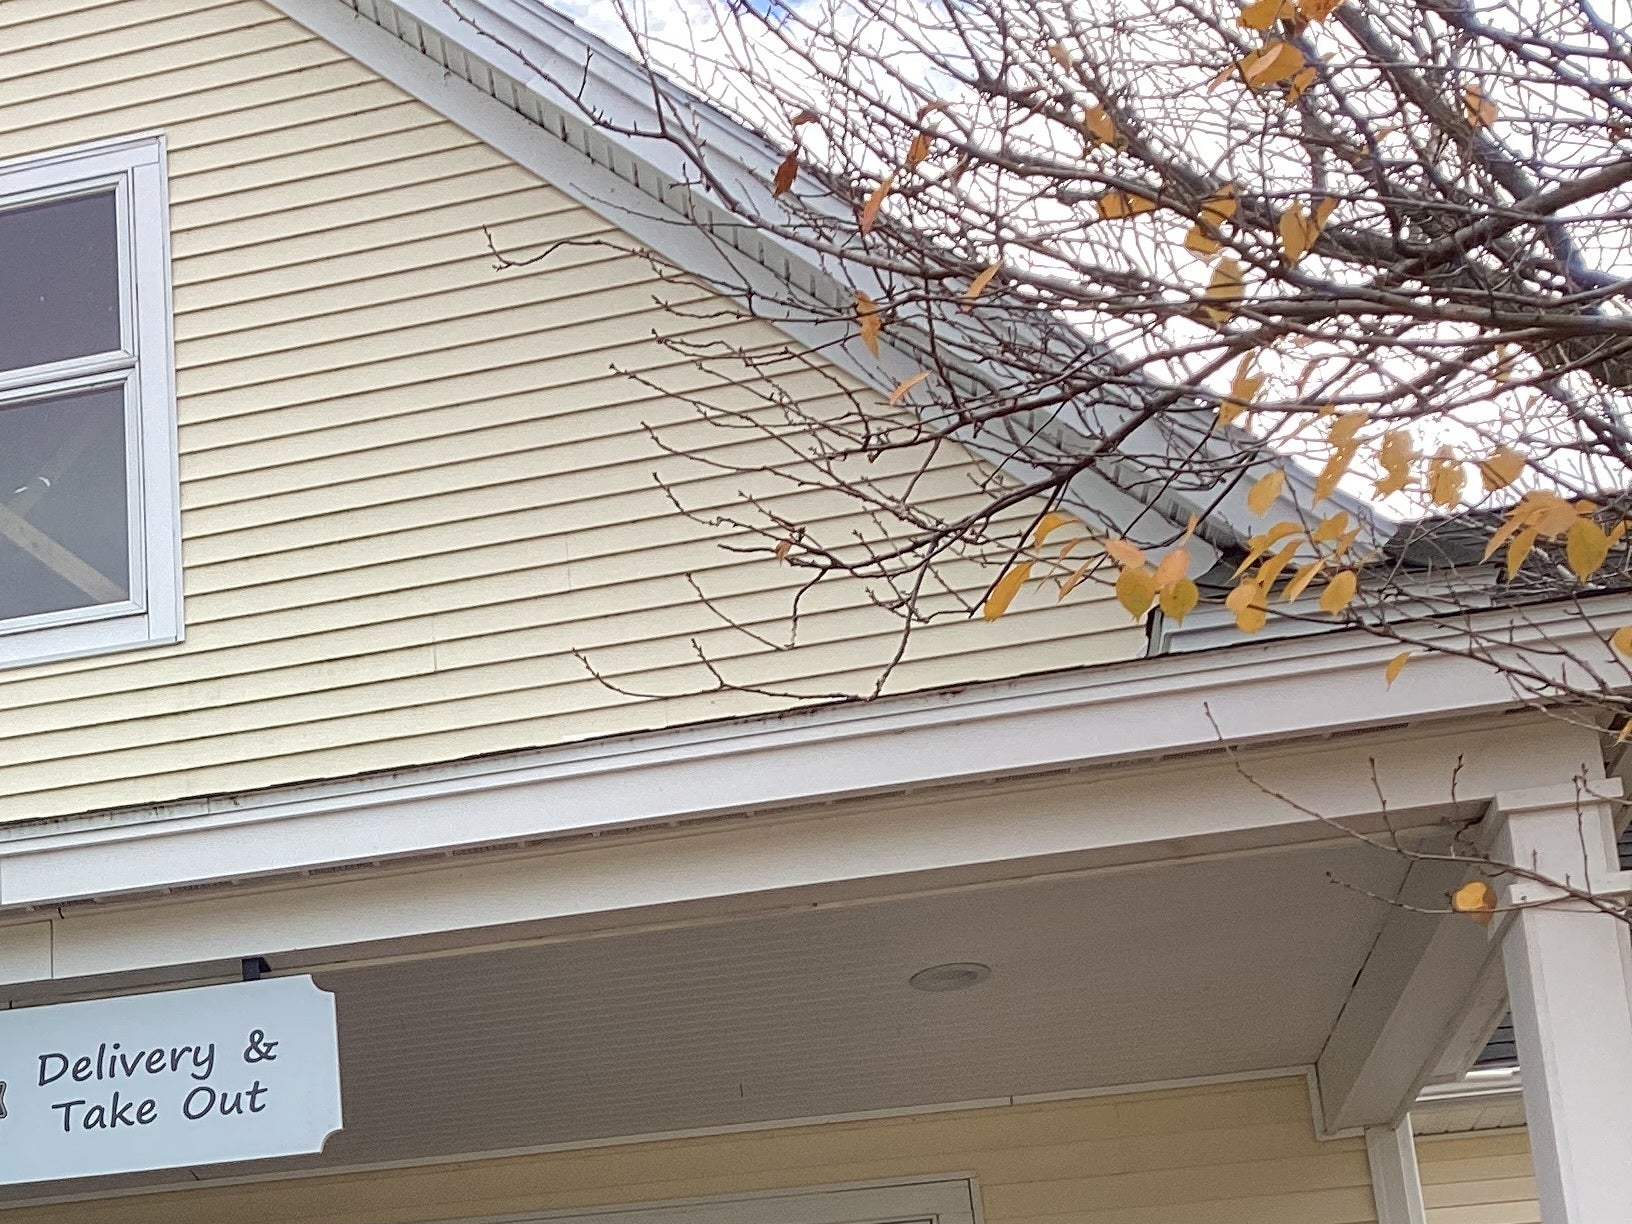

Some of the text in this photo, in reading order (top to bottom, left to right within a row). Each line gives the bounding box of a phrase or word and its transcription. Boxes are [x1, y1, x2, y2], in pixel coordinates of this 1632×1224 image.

[38, 1029, 279, 1088] Delivery &
[51, 1080, 268, 1133] Take Out
